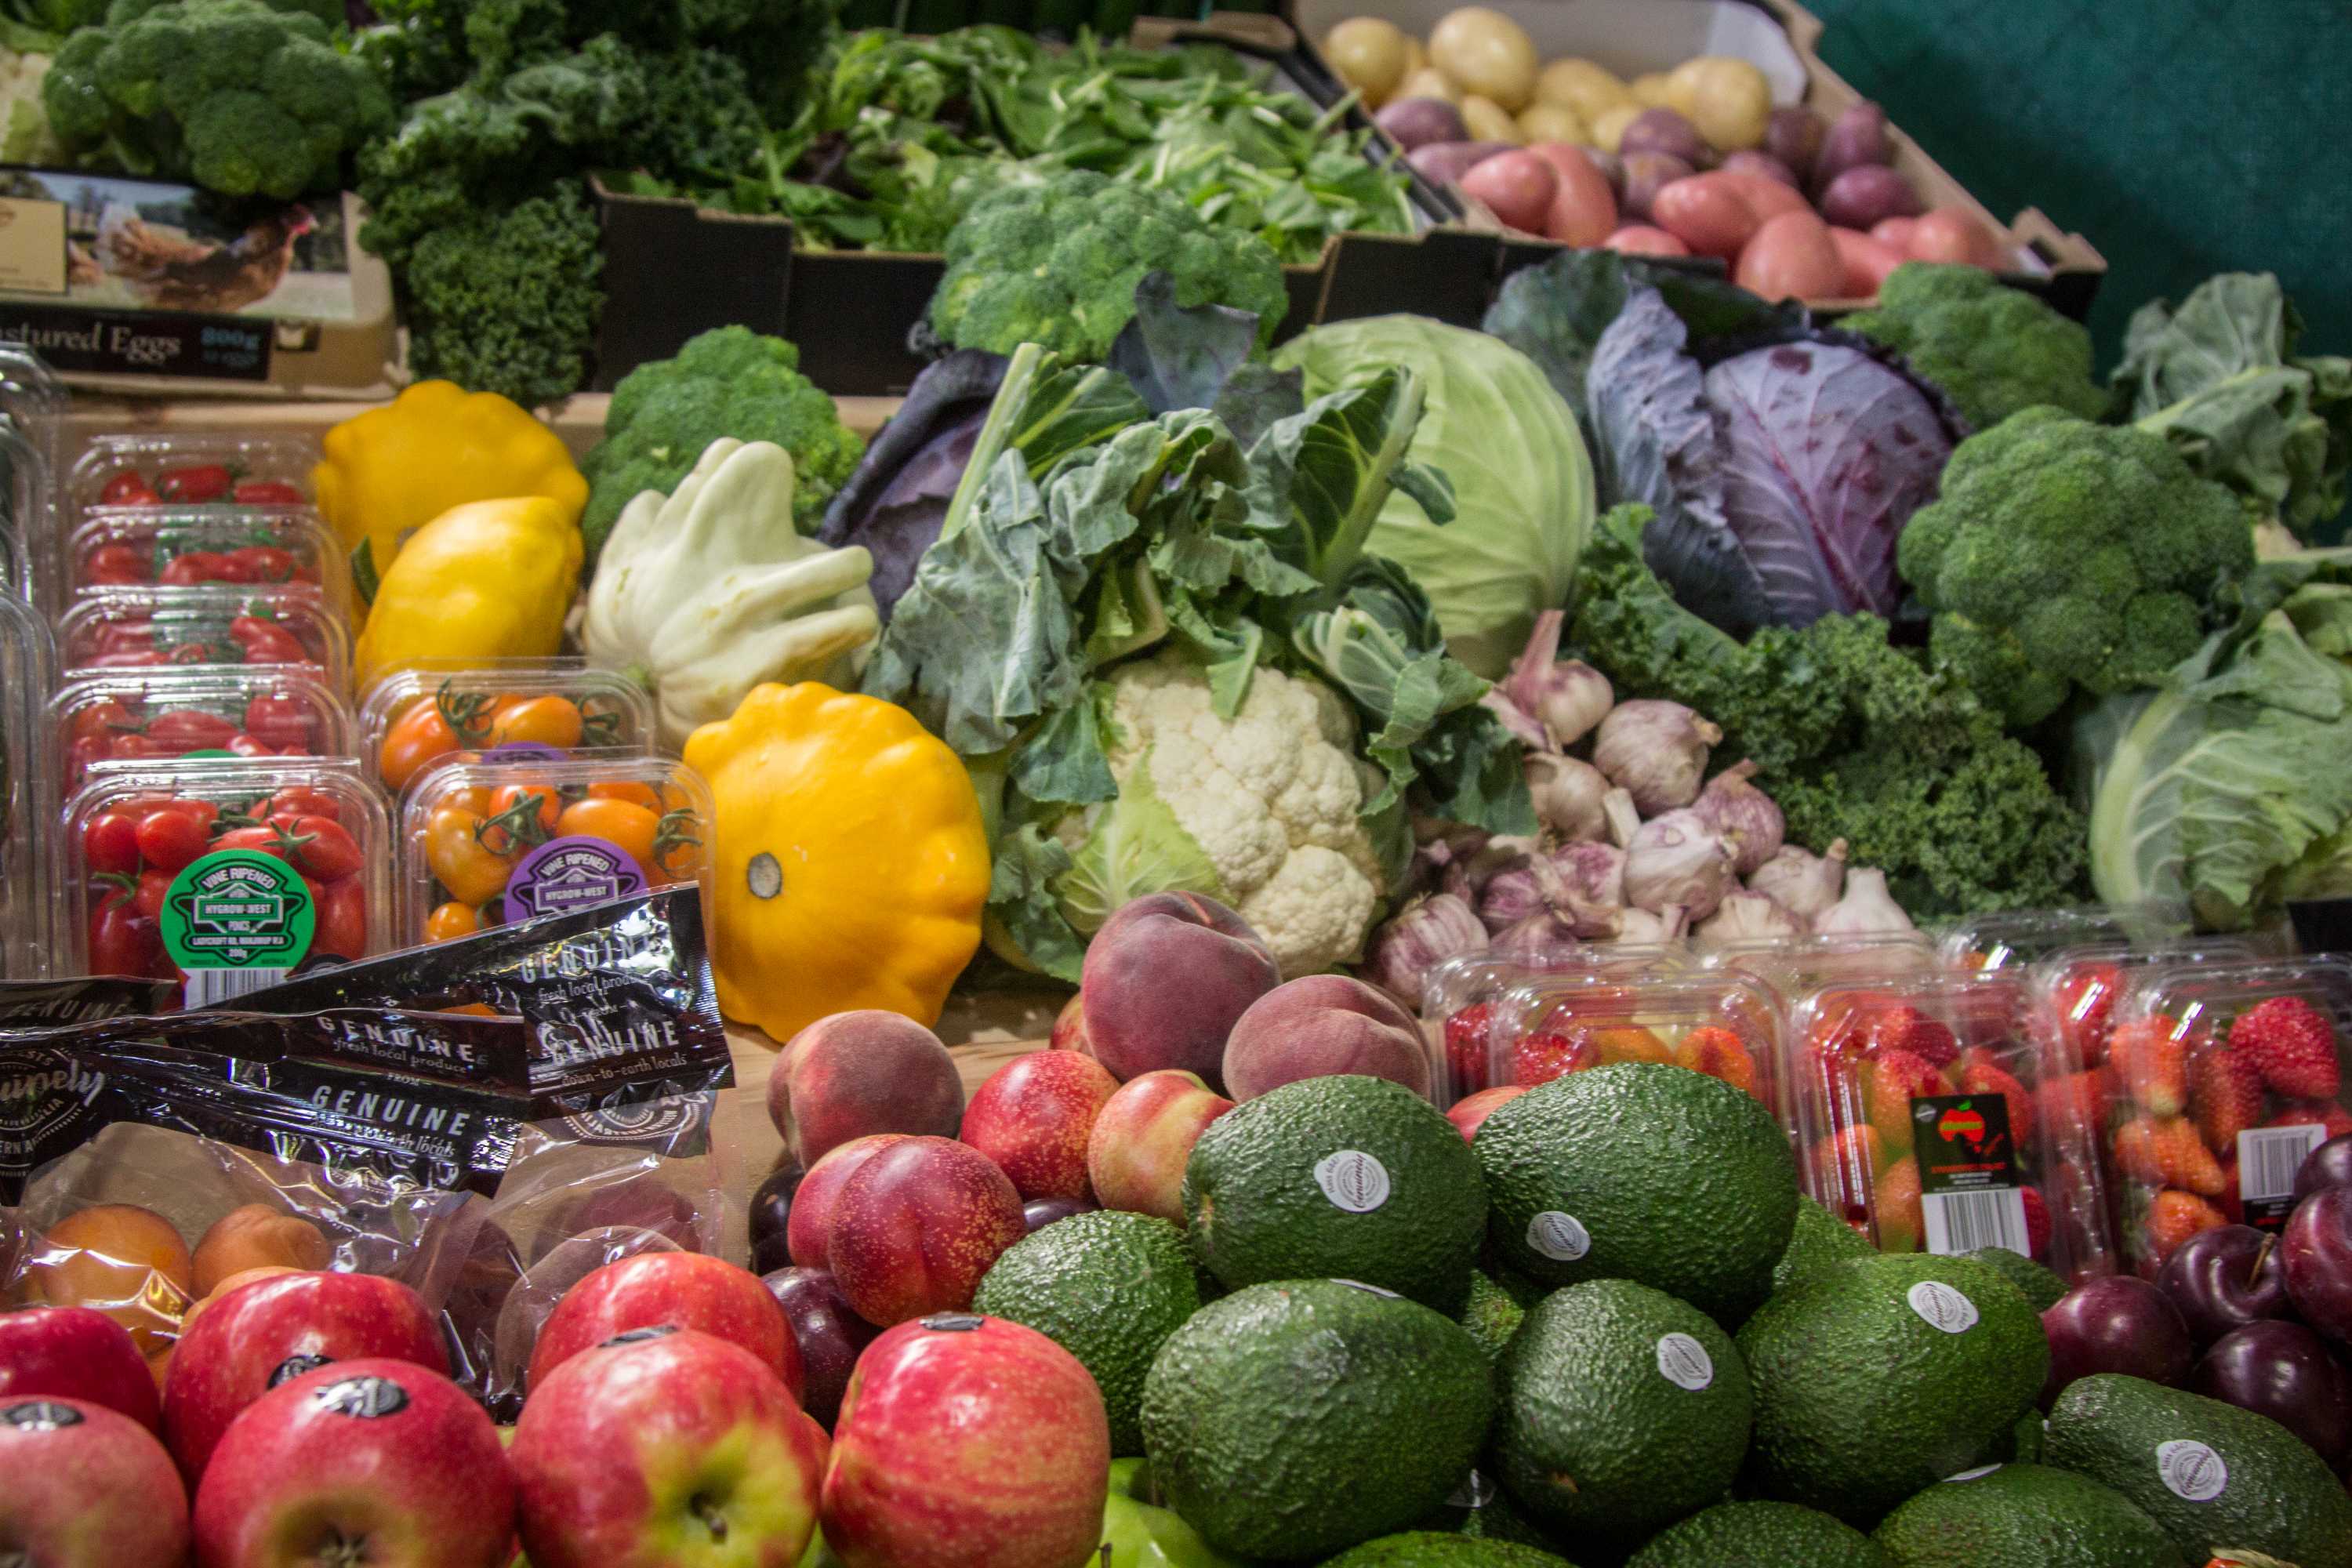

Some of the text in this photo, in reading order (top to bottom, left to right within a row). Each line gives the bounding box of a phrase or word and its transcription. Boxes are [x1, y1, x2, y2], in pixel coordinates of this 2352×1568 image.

[111, 326, 182, 364] Eggs
[201, 867, 276, 889] VINE RIPENED
[541, 853, 610, 877] VINE RIPENED
[228, 949, 248, 959] 200g
[537, 984, 568, 1009] fresh
[568, 978, 599, 997] local
[317, 1016, 475, 1062] GENUINE
[334, 1036, 469, 1073] fresh local produce
[654, 1052, 688, 1071] locals
[387, 1072, 420, 1087] FROM
[314, 1085, 470, 1136] GENUINE
